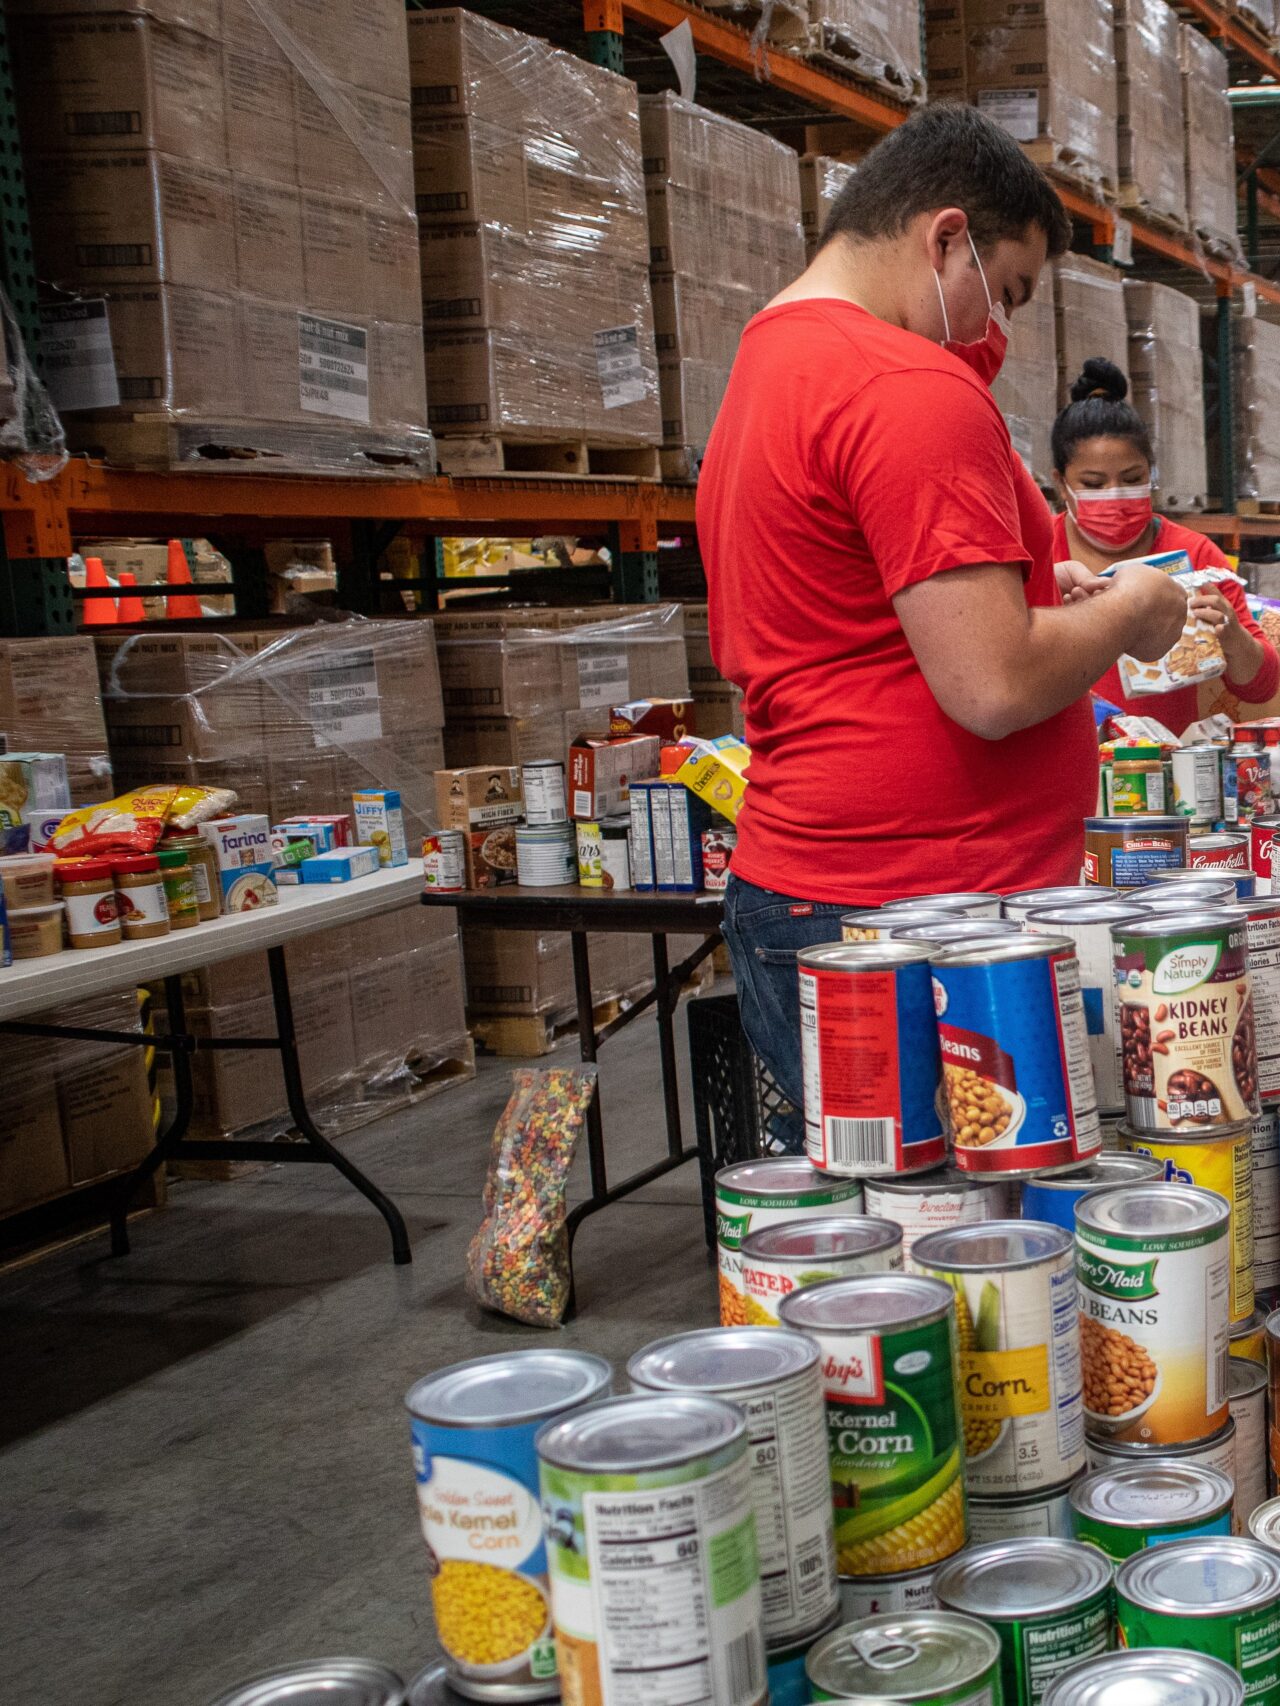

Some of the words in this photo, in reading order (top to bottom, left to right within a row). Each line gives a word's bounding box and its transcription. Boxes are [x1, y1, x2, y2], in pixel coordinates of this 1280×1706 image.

[692, 761, 721, 793] Cheerios
[481, 810, 496, 819] HIGH
[497, 808, 515, 817] FIBER
[222, 832, 267, 853] farina
[1169, 954, 1208, 970] Simply
[1169, 997, 1229, 1019] KIDNEY
[1179, 1016, 1228, 1040] BEANS
[739, 1198, 758, 1206] LOW
[760, 1199, 799, 1207] SODIUM
[832, 1193, 847, 1201] LOW
[718, 1215, 742, 1238] Maid
[1142, 1243, 1166, 1251] LOW
[1168, 1237, 1205, 1249] SODIUM
[1093, 1263, 1145, 1288] Maid
[1090, 1299, 1158, 1325] BEANS
[828, 1410, 897, 1428] Kernel
[837, 1431, 914, 1454] Corn
[1018, 1445, 1039, 1459] 3.5
[755, 1447, 776, 1463] 60
[657, 1494, 695, 1512] Facts
[450, 1511, 517, 1529] Kernel
[468, 1532, 521, 1551] Corn
[600, 1554, 653, 1566] Calories
[1028, 1624, 1082, 1645] Nutrition
[1243, 1672, 1278, 1692] Calories
